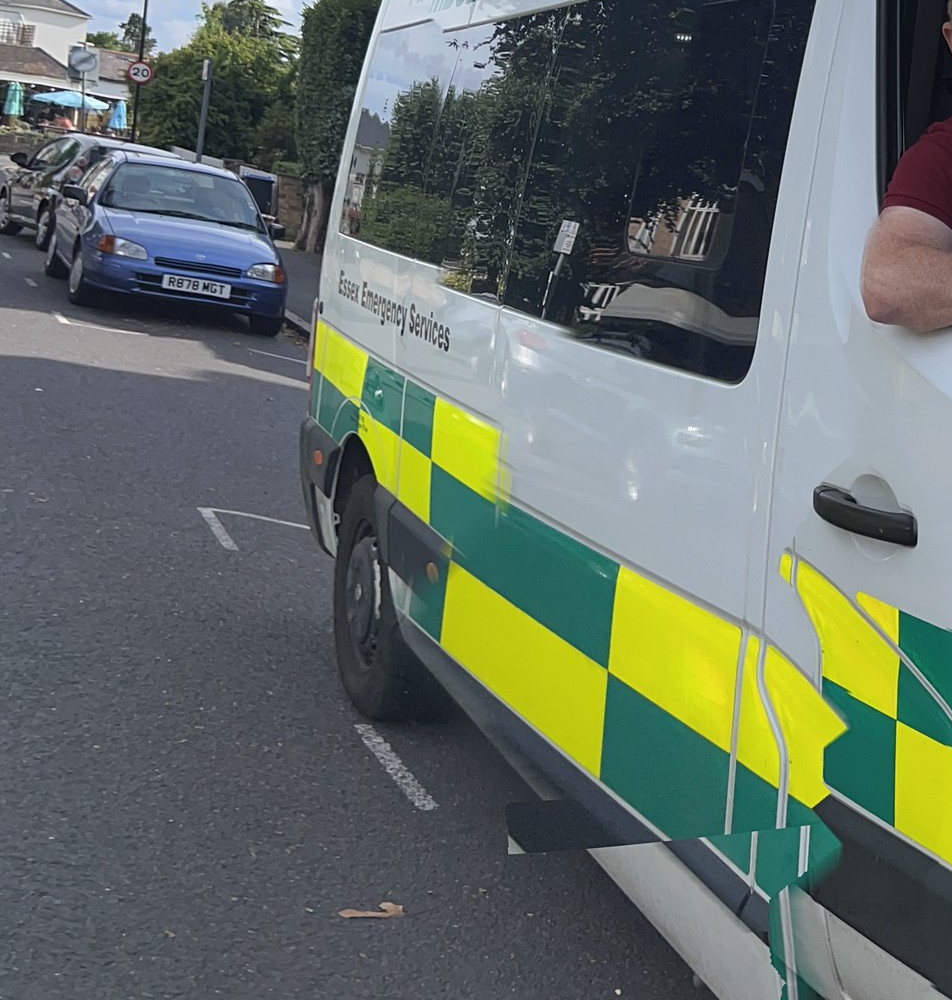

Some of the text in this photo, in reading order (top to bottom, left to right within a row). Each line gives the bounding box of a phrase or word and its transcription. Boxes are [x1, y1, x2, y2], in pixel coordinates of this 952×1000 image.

[132, 67, 150, 78] 20
[168, 276, 226, 296] R878 MGT
[339, 269, 450, 352] Essex Emergency Services
